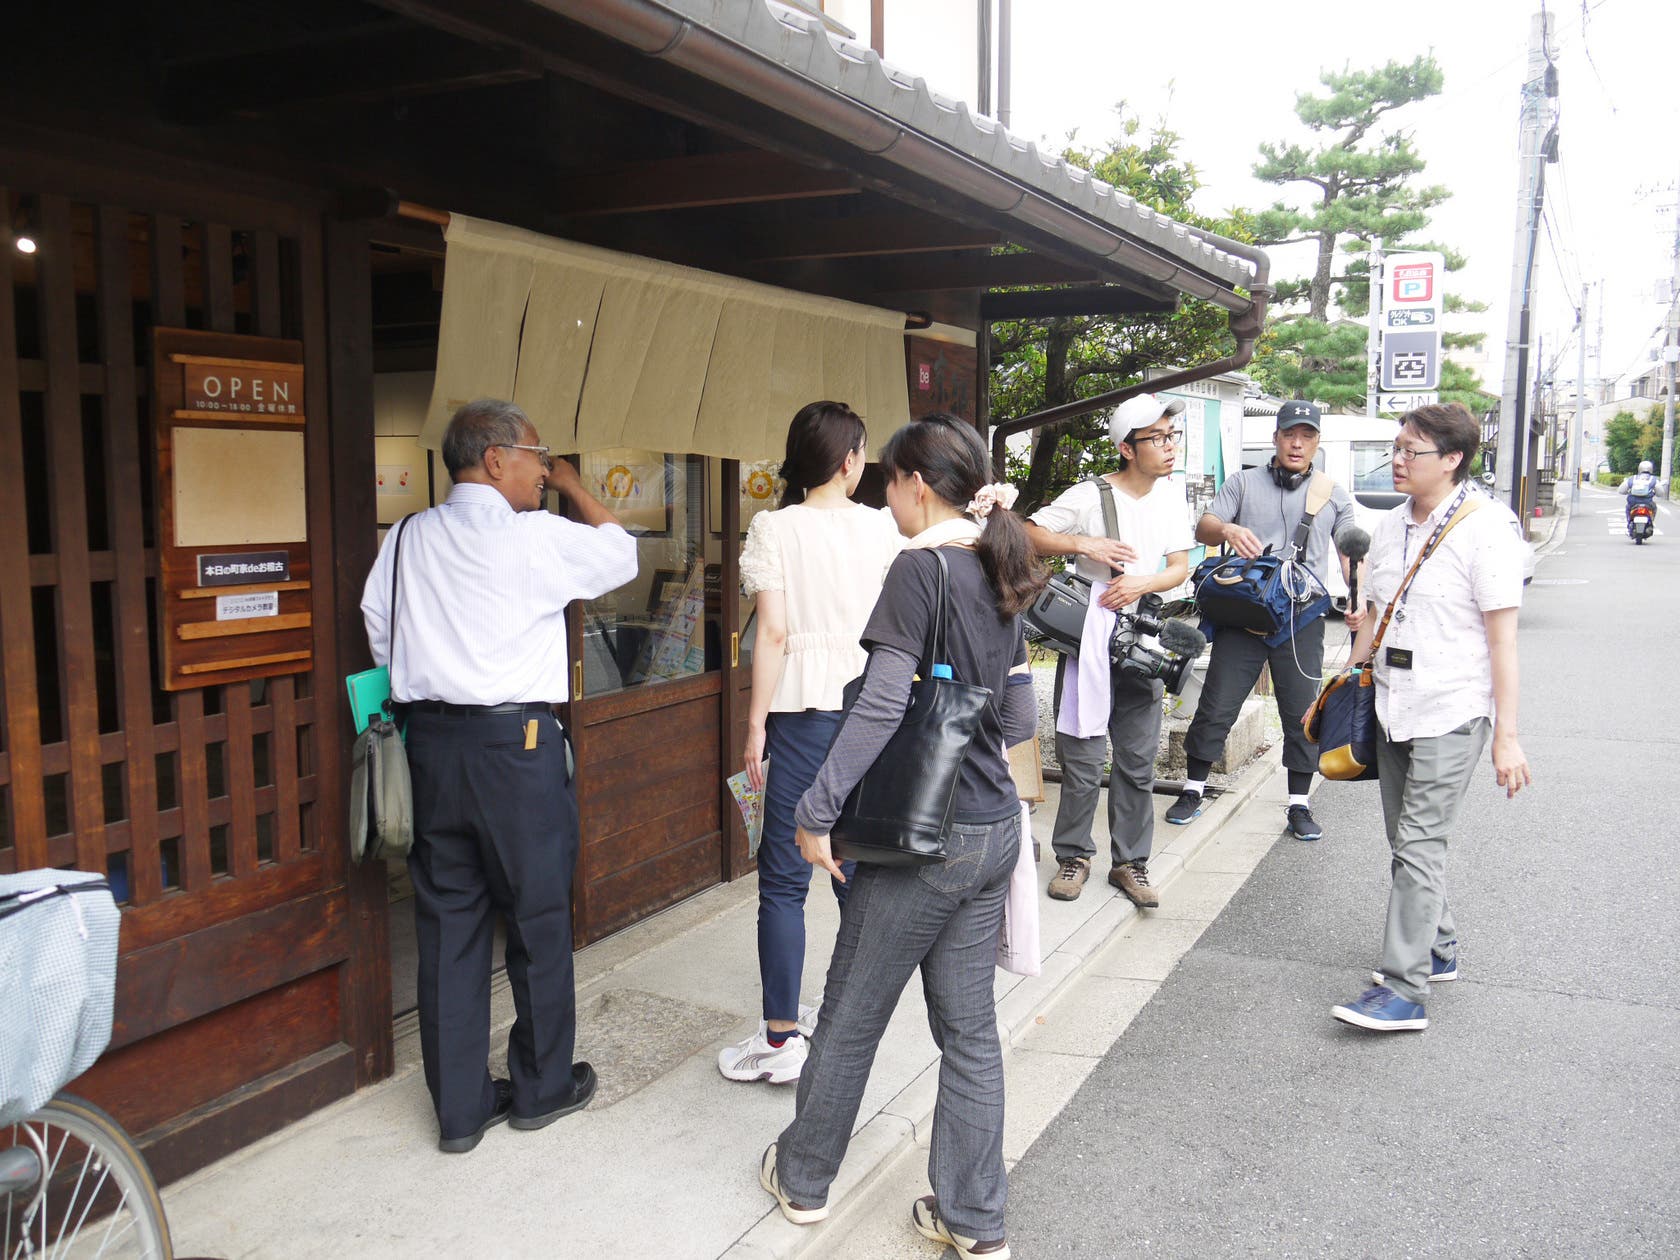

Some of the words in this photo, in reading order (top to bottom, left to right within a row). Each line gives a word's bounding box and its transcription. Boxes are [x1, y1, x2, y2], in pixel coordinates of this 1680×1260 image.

[1405, 282, 1421, 295] P
[1392, 318, 1408, 326] OK
[919, 367, 930, 384] be
[1393, 352, 1427, 384] 空
[203, 376, 289, 401] OPEN
[1410, 395, 1431, 409] IN
